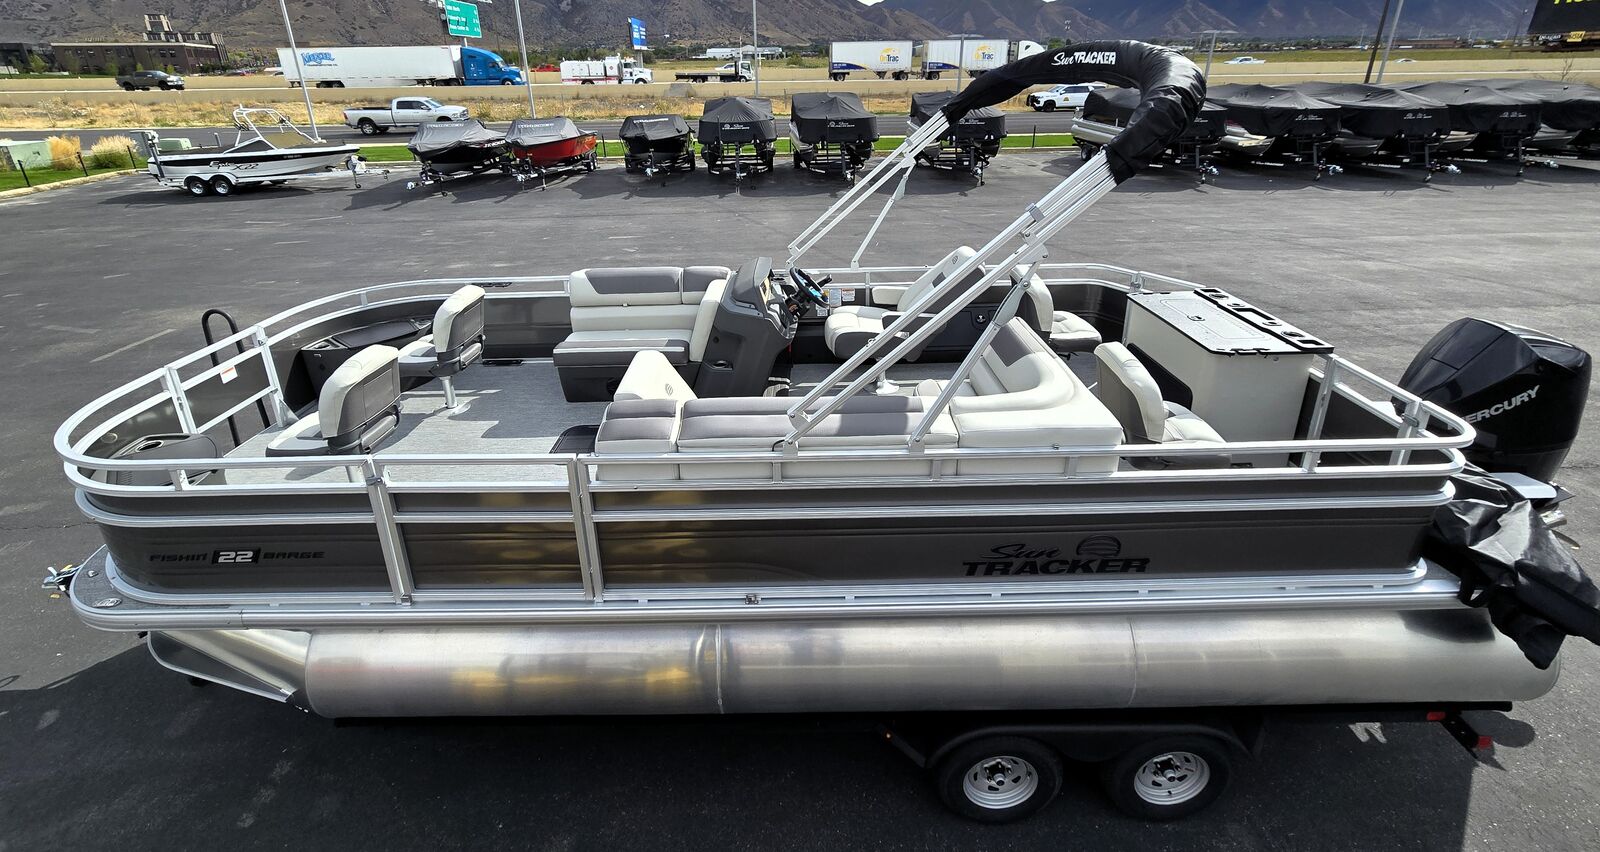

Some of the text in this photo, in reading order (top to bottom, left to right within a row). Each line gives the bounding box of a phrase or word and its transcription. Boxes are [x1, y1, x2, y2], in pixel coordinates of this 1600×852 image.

[1051, 51, 1117, 66] Sun TRACKER
[1460, 384, 1540, 424] ERCURY
[217, 550, 254, 564] 22
[262, 550, 326, 560] BARGE
[979, 543, 1062, 560] Sun
[962, 557, 1151, 577] TRACKER
